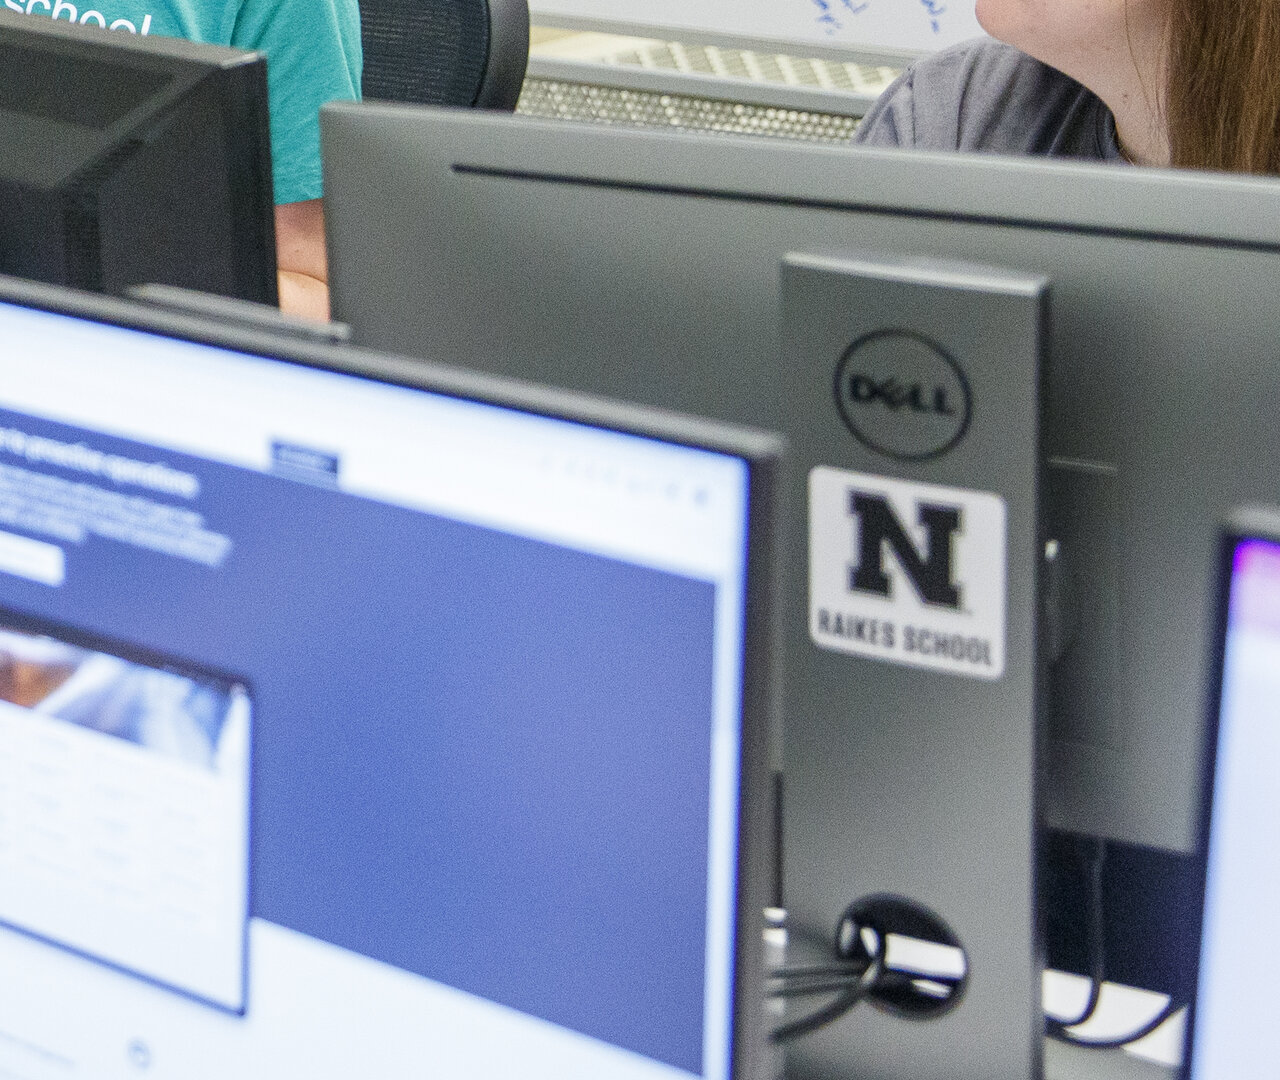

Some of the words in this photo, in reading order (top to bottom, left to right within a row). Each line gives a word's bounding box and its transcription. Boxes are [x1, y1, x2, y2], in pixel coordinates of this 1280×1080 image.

[849, 373, 956, 418] DELL
[848, 485, 967, 612] N
[816, 607, 897, 649] RAIKES
[902, 624, 993, 668] SCHOOL
